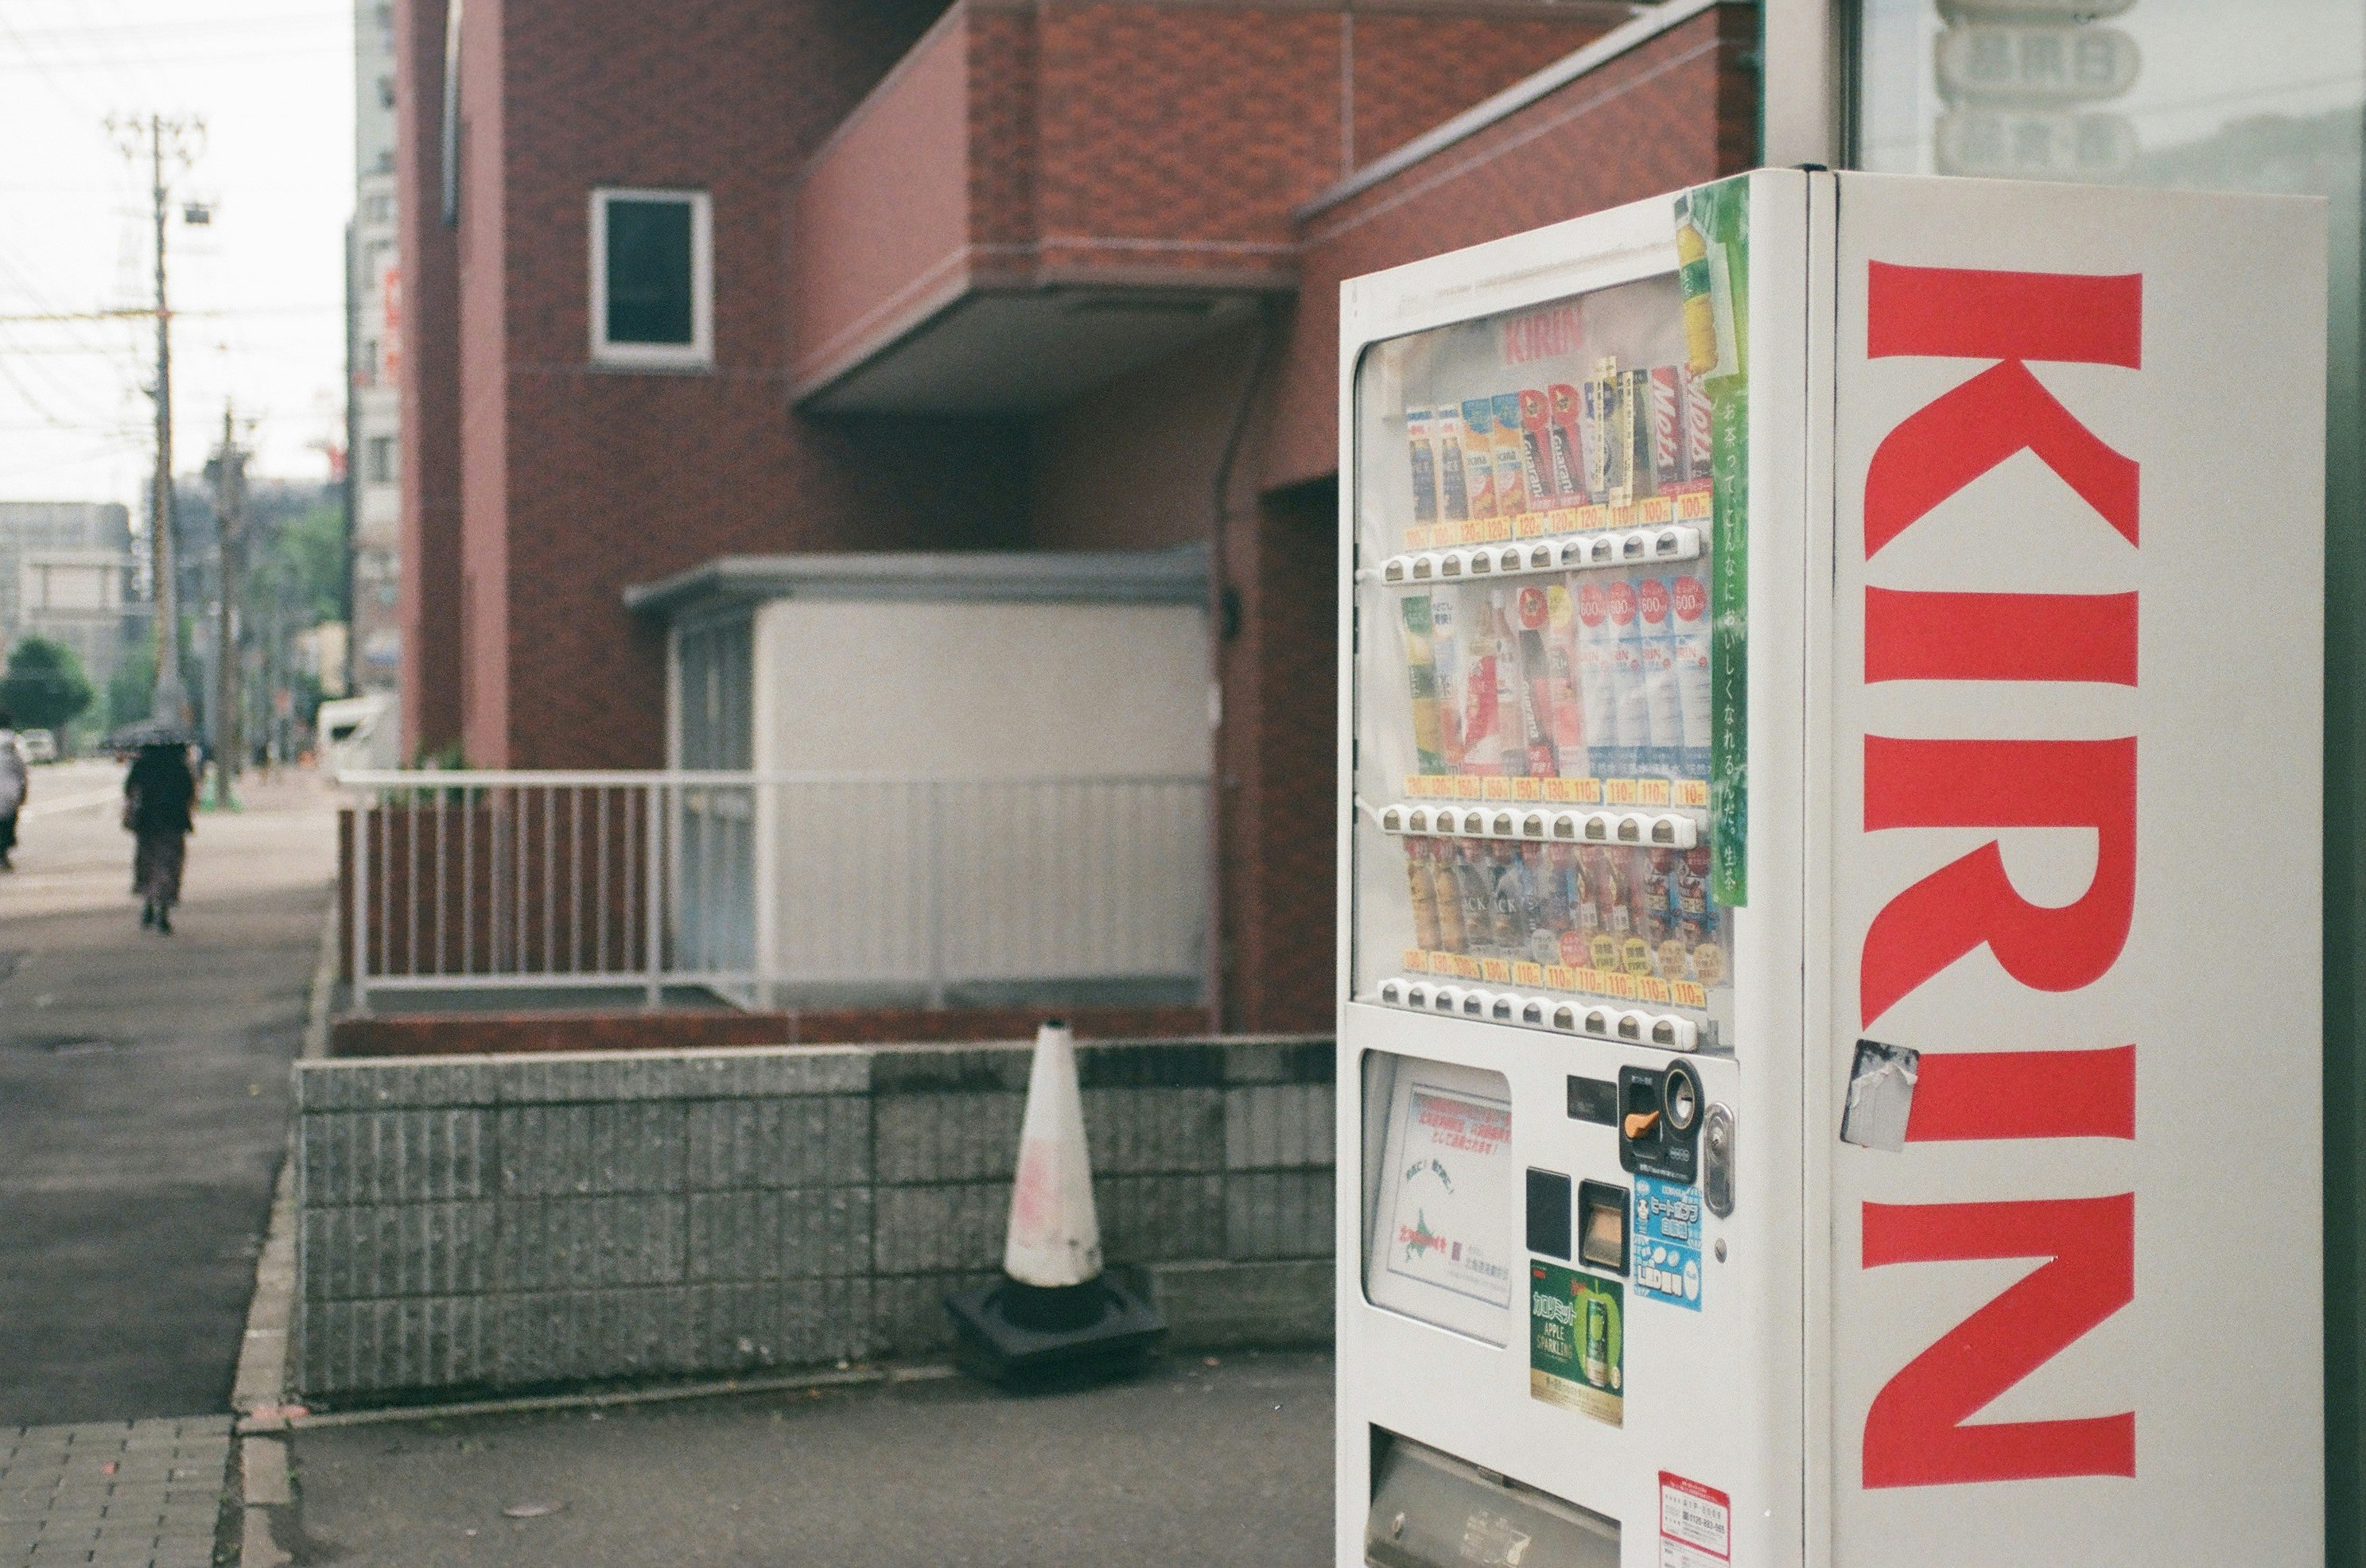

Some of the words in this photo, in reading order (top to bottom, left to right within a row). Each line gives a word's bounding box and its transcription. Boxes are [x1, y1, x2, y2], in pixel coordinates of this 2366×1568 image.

[1723, 844, 1737, 891] 生茶
[1860, 259, 2143, 1488] KIRIN
[1544, 1321, 1565, 1341] APPLE
